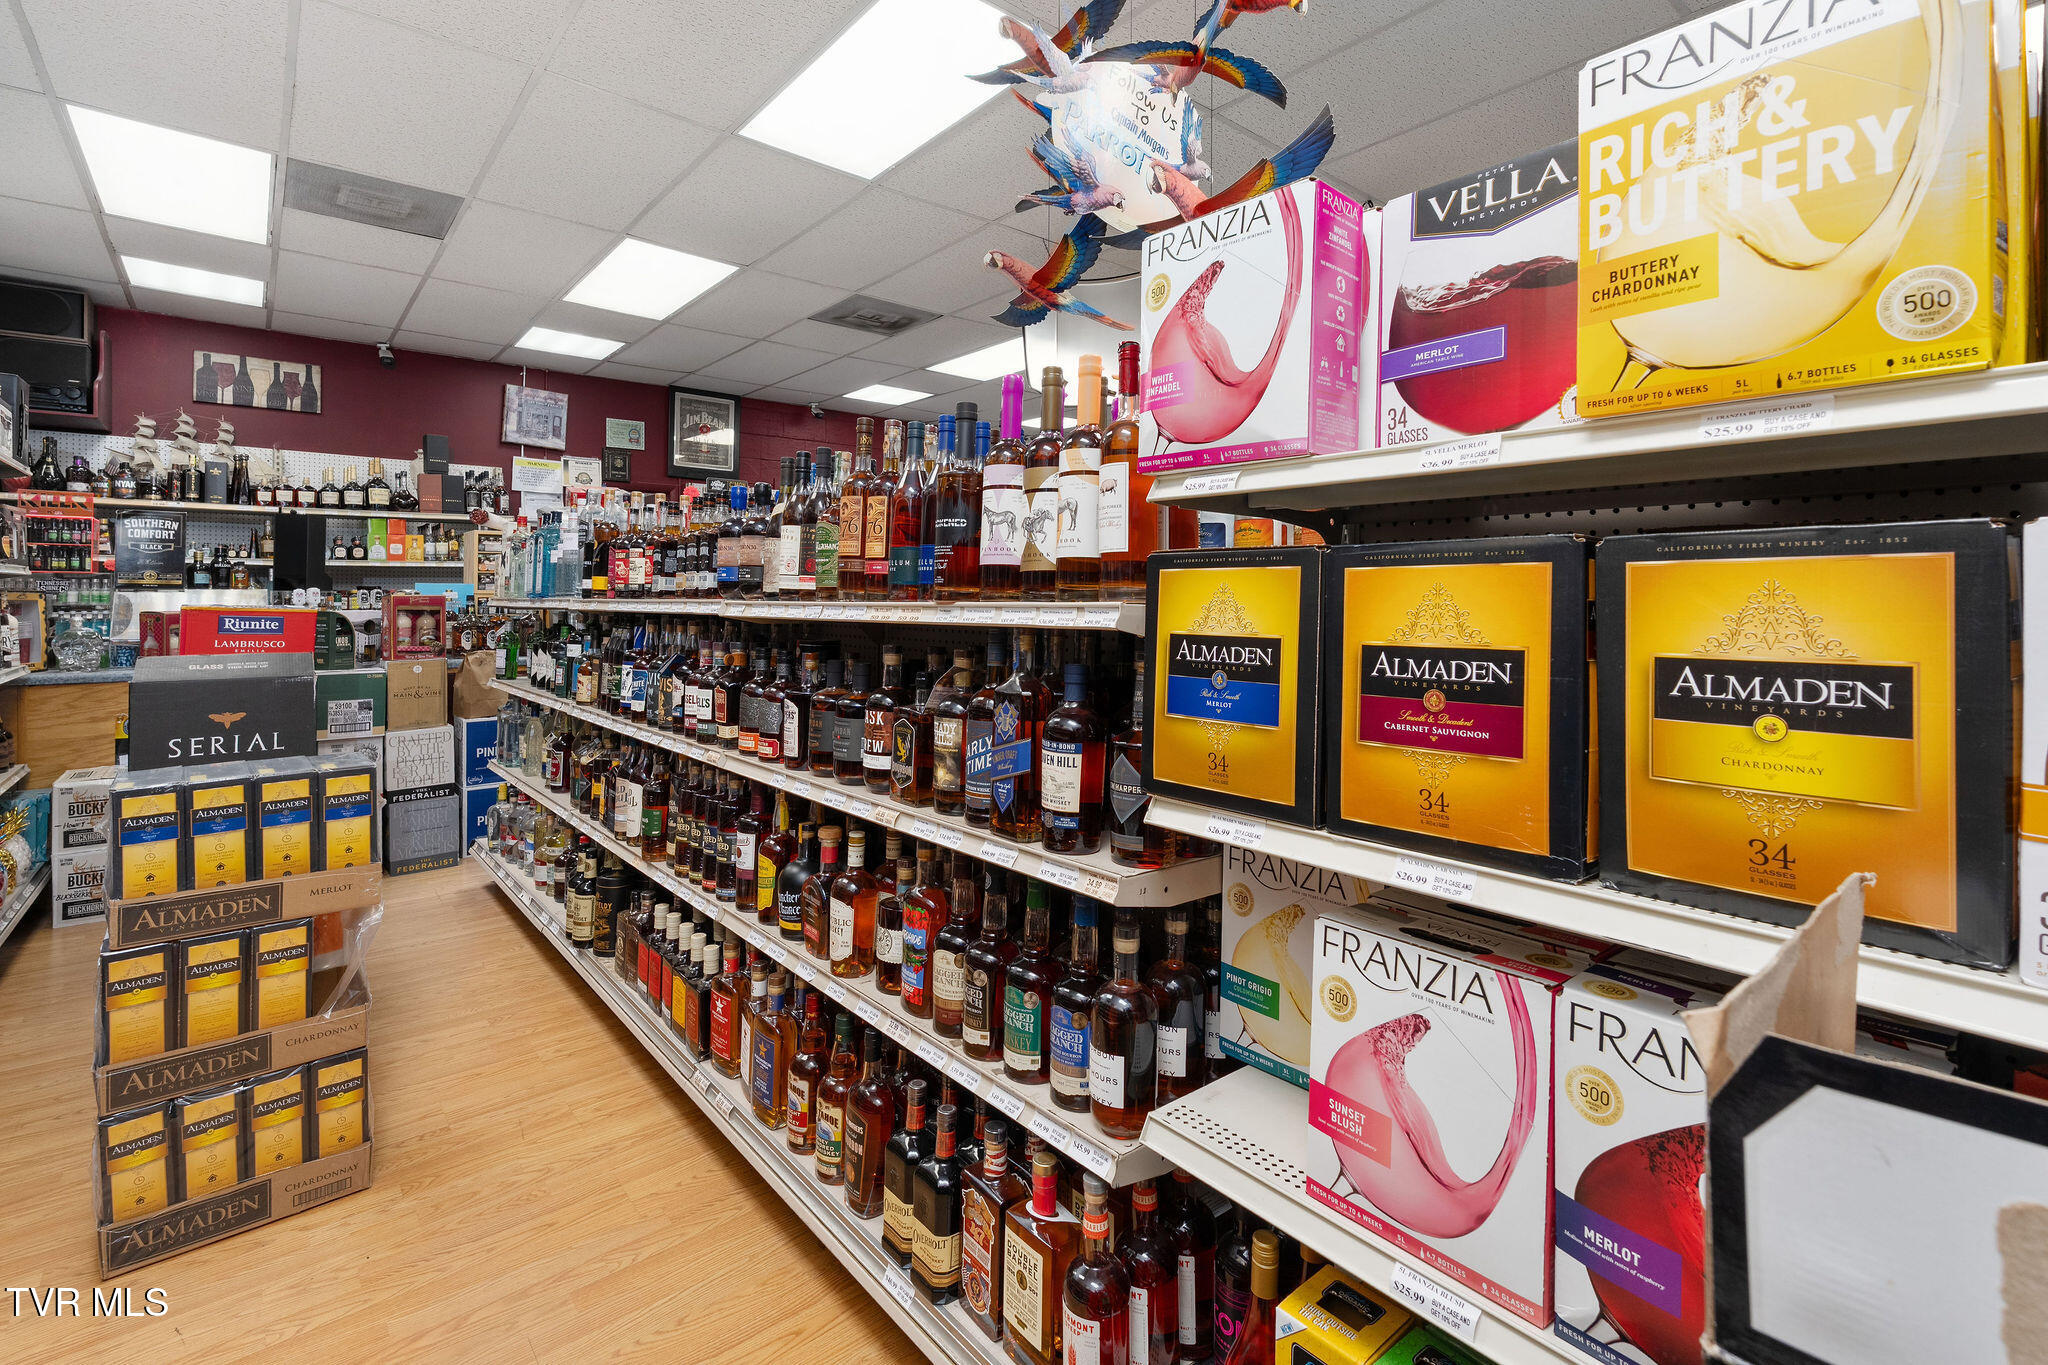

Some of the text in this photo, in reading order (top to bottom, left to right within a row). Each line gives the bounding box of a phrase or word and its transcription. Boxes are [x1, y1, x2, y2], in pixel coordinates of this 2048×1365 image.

[1131, 102, 1150, 126] To
[1161, 107, 1179, 132] Us
[1589, 74, 1811, 193] RICH &
[1137, 130, 1171, 161] Morgan's
[1476, 163, 1514, 180] PETER
[1589, 105, 1914, 252] BUTTERY
[1427, 157, 1571, 223] VELLA
[1321, 188, 1359, 222] FRANZIA
[1452, 197, 1538, 228] VINEYARDS
[1147, 199, 1272, 268] FRANZIA
[1609, 254, 1680, 284] BUTTERY
[1151, 283, 1166, 299] 500
[1591, 265, 1700, 303] CHARDONNAY
[1903, 289, 1952, 313] 500
[1415, 344, 1459, 361] MERLOT
[1902, 346, 1980, 366] 34 GLASSES
[1151, 372, 1174, 386] WHITE
[1787, 371, 1803, 381] 6.7
[1807, 363, 1857, 379] BOTTLES
[1587, 384, 1709, 409] FRESH FOR UP TO 6 WEEKS
[681, 412, 728, 430] JIM BEAM
[1387, 406, 1408, 431] 34
[1387, 427, 1429, 446] GLASSES
[1703, 424, 1754, 438] $25.99
[1420, 459, 1454, 469] $26.99
[114, 480, 137, 488] NYAK
[123, 518, 180, 531] SOUTHERN
[127, 528, 175, 540] COMFORT
[140, 543, 163, 551] BLACK
[1656, 542, 1734, 553] CALIFORNIA'S
[1738, 541, 1773, 550] FIRST
[1778, 539, 1826, 550] WINERY
[1878, 536, 1910, 545] 1852
[223, 617, 279, 632] Riunite
[214, 639, 286, 649] LAMBRUSCO
[1175, 639, 1273, 667] ALMADEN
[188, 663, 224, 671] GLASS
[1191, 662, 1252, 673] VINEYARDS
[1371, 650, 1512, 685] ALMADEN
[413, 687, 424, 699] &
[1394, 680, 1481, 693] VINEYARDS
[1669, 665, 1892, 711] ALMADEN
[1205, 700, 1233, 709] MERLOT
[1705, 702, 1844, 719] VINEYARDS
[388, 731, 451, 748] CRAFTED
[1384, 721, 1490, 740] CABERNET SAUVIGNON
[167, 732, 286, 759] SERIAL
[420, 742, 444, 755] THE
[395, 752, 446, 769] PEOPLE
[423, 762, 451, 774] THE
[1057, 755, 1078, 769] HILL
[1207, 751, 1229, 772] 34
[1721, 756, 1825, 776] CHARDONNAY
[396, 775, 446, 789] PEOPLE
[264, 799, 309, 811] ALMADEN
[327, 793, 370, 805] ALMADEN
[392, 789, 451, 802] FEDERALIST
[1418, 788, 1450, 813] 34
[124, 815, 175, 828] ALMADEN
[195, 806, 243, 819] ALMADEN
[1419, 811, 1450, 821] GLASSES
[1748, 838, 1796, 870] 34
[396, 857, 454, 874] FEDERALIST
[1228, 845, 1347, 901] FRANZIA
[1748, 867, 1797, 880] GLASSES
[1395, 870, 1428, 886] $26.99
[132, 883, 353, 932] ALMADEN MERLOT
[1233, 893, 1249, 906] 500
[159, 914, 247, 934] VINEYARDS
[261, 945, 306, 962] ALMADEN
[190, 959, 238, 975] ALMADEN
[1322, 924, 1495, 1015] FRANZIA
[111, 974, 163, 992] ALMADEN
[1225, 971, 1273, 998] PINOT GRIGIO
[1616, 973, 1658, 990] MERLOT
[1327, 987, 1350, 1007] 500
[1411, 991, 1496, 1025] OVER 100 YEARS OF WINEMAKING
[121, 1022, 361, 1096] ALMADEN CHARDONNAY
[320, 1077, 361, 1097] ALMADEN
[1578, 1082, 1611, 1107] 500
[256, 1094, 301, 1114] ALMADEN
[1328, 1098, 1366, 1124] SUNSET
[187, 1113, 234, 1135] ALMADEN
[1031, 1118, 1050, 1134] $49.99
[1331, 1111, 1362, 1137] BLUSH
[112, 1133, 163, 1156] ALMADEN
[1072, 1140, 1092, 1156] $45.99
[120, 1162, 361, 1254] ALMADEN CHARDONNAY
[912, 1229, 948, 1251] OVERHOLT
[1582, 1225, 1643, 1268] MERLOT
[1006, 1238, 1039, 1270] DOUBLE
[1426, 1250, 1467, 1278] 6.7 BOTTLES
[1006, 1250, 1039, 1282] BARREL
[1392, 1279, 1426, 1306] $25.99
[1490, 1285, 1535, 1317] 34 GLASSES
[1298, 1309, 1314, 1323] THE
[1303, 1301, 1360, 1341] THINK OUTSIDE
[1430, 1307, 1462, 1331] GET 10% OFF
[1279, 1322, 1296, 1335] NEW!
[1558, 1323, 1618, 1360] FRESH FOR UP
